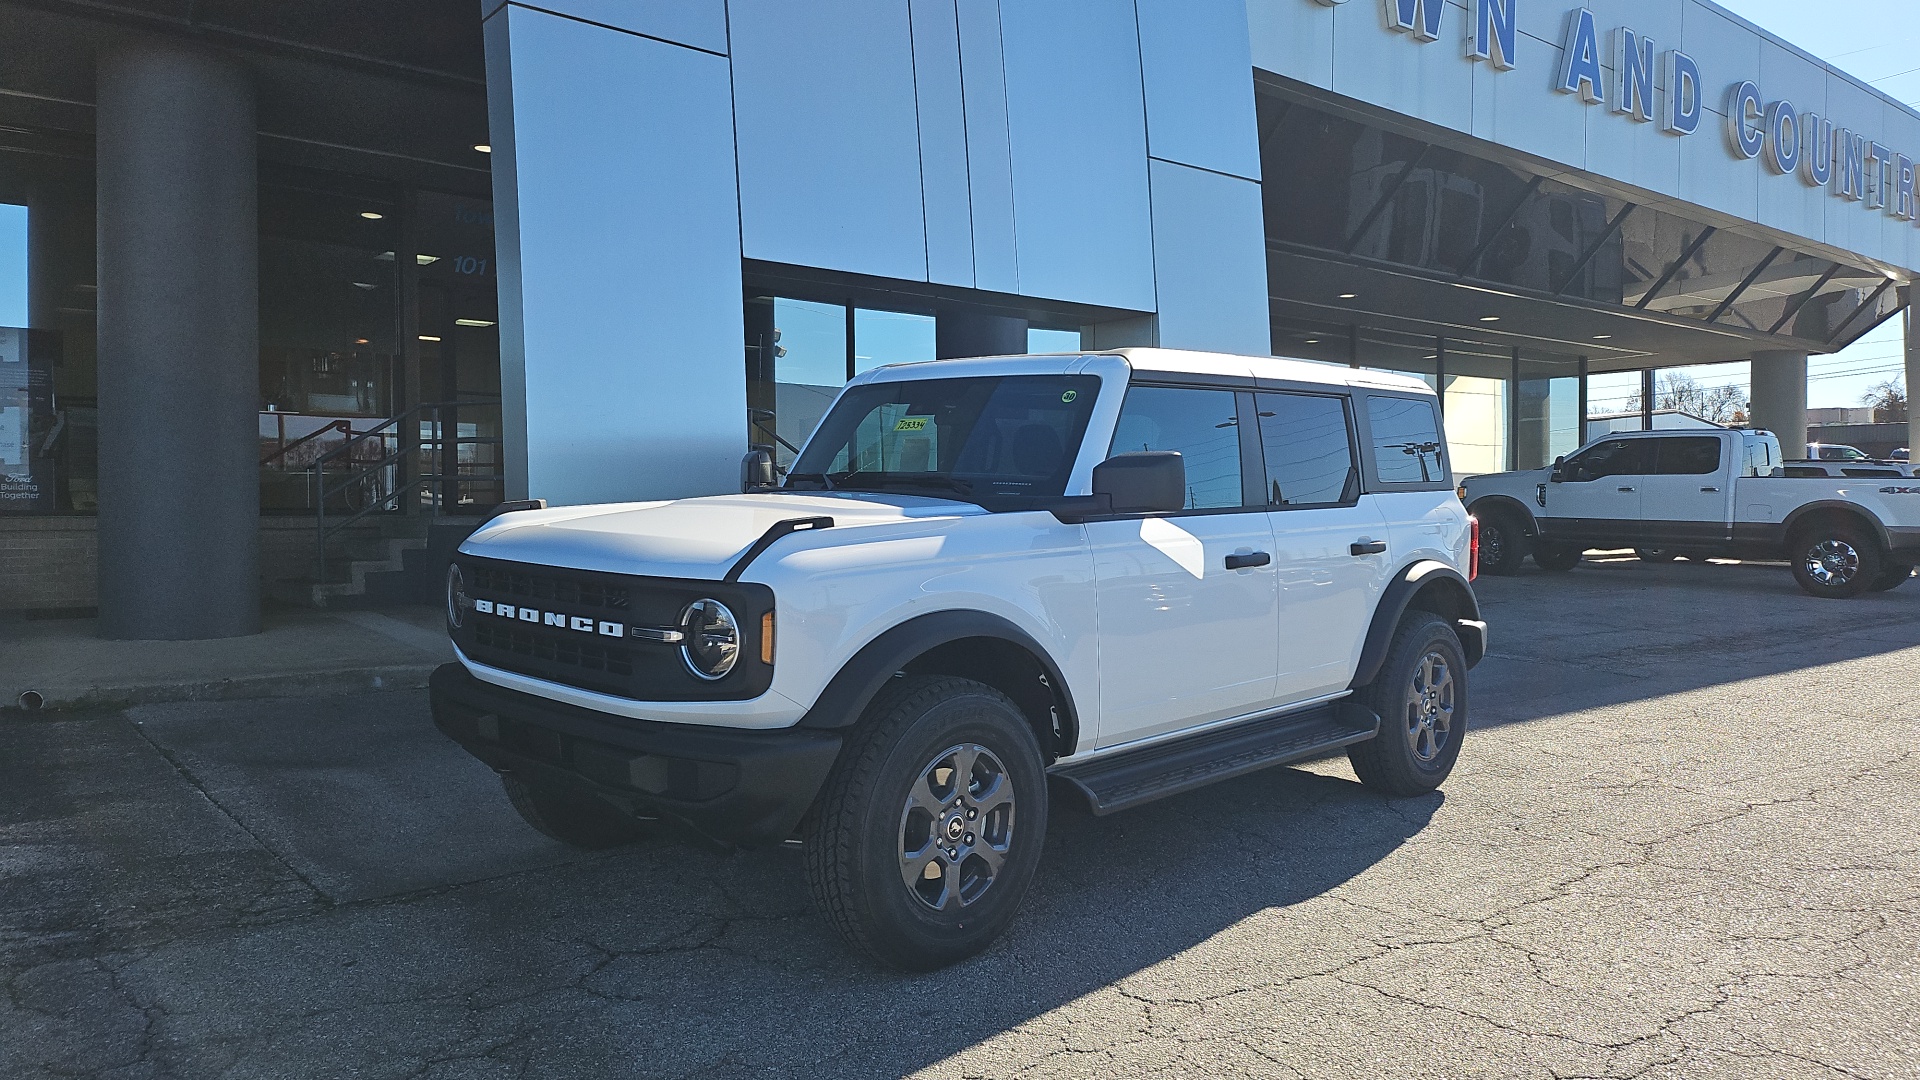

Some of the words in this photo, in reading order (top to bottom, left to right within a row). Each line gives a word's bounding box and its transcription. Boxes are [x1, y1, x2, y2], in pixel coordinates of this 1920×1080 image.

[1557, 7, 1702, 135] AND
[1728, 80, 1920, 226] COUNTR
[454, 256, 487, 276] 101
[5, 472, 33, 483] Ford
[0, 483, 38, 492] Building
[0, 491, 40, 500] Together
[475, 599, 624, 638] BRONCO
